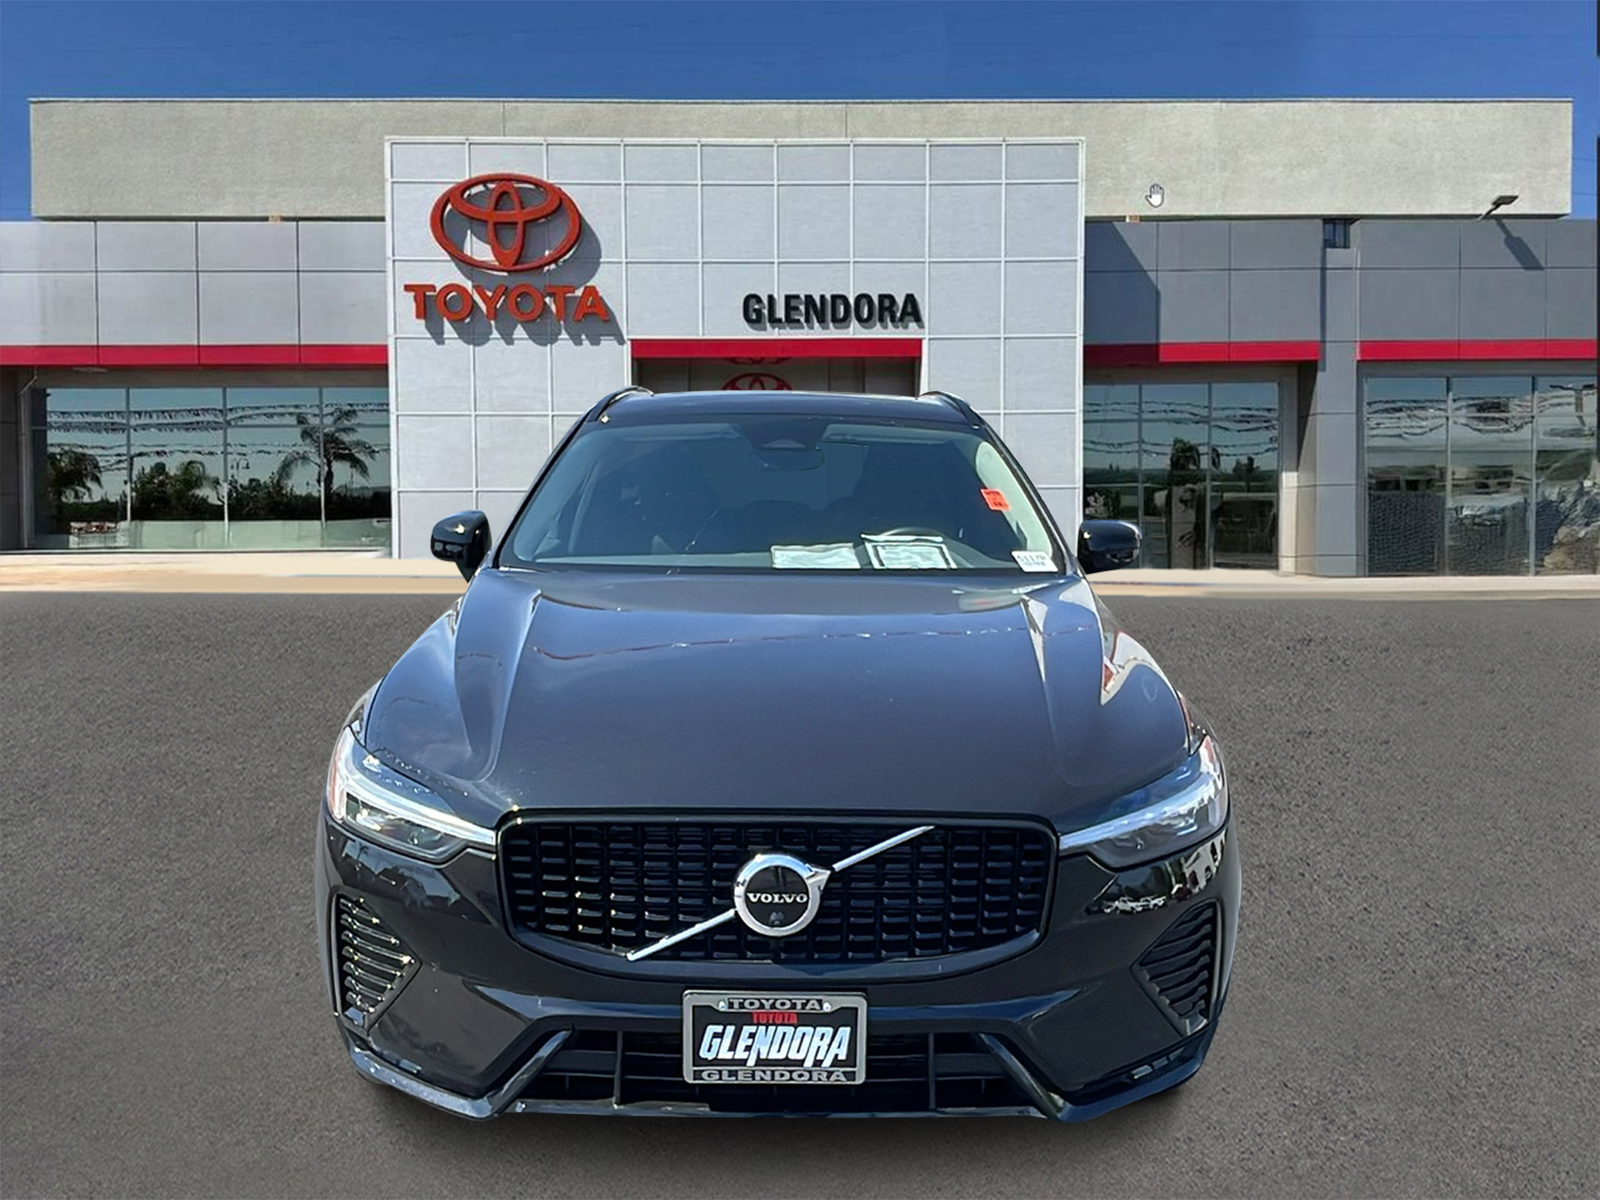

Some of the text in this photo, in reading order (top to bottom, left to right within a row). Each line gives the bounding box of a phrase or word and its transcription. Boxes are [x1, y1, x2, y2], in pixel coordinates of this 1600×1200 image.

[404, 284, 609, 322] TOYOTA
[743, 293, 922, 324] GLENDORA
[746, 893, 808, 903] VOLVO
[730, 999, 821, 1010] TOYOTA
[752, 1012, 797, 1024] TOYOTA
[699, 1025, 851, 1067] GLENDORA
[701, 1070, 847, 1081] GLENDORA
